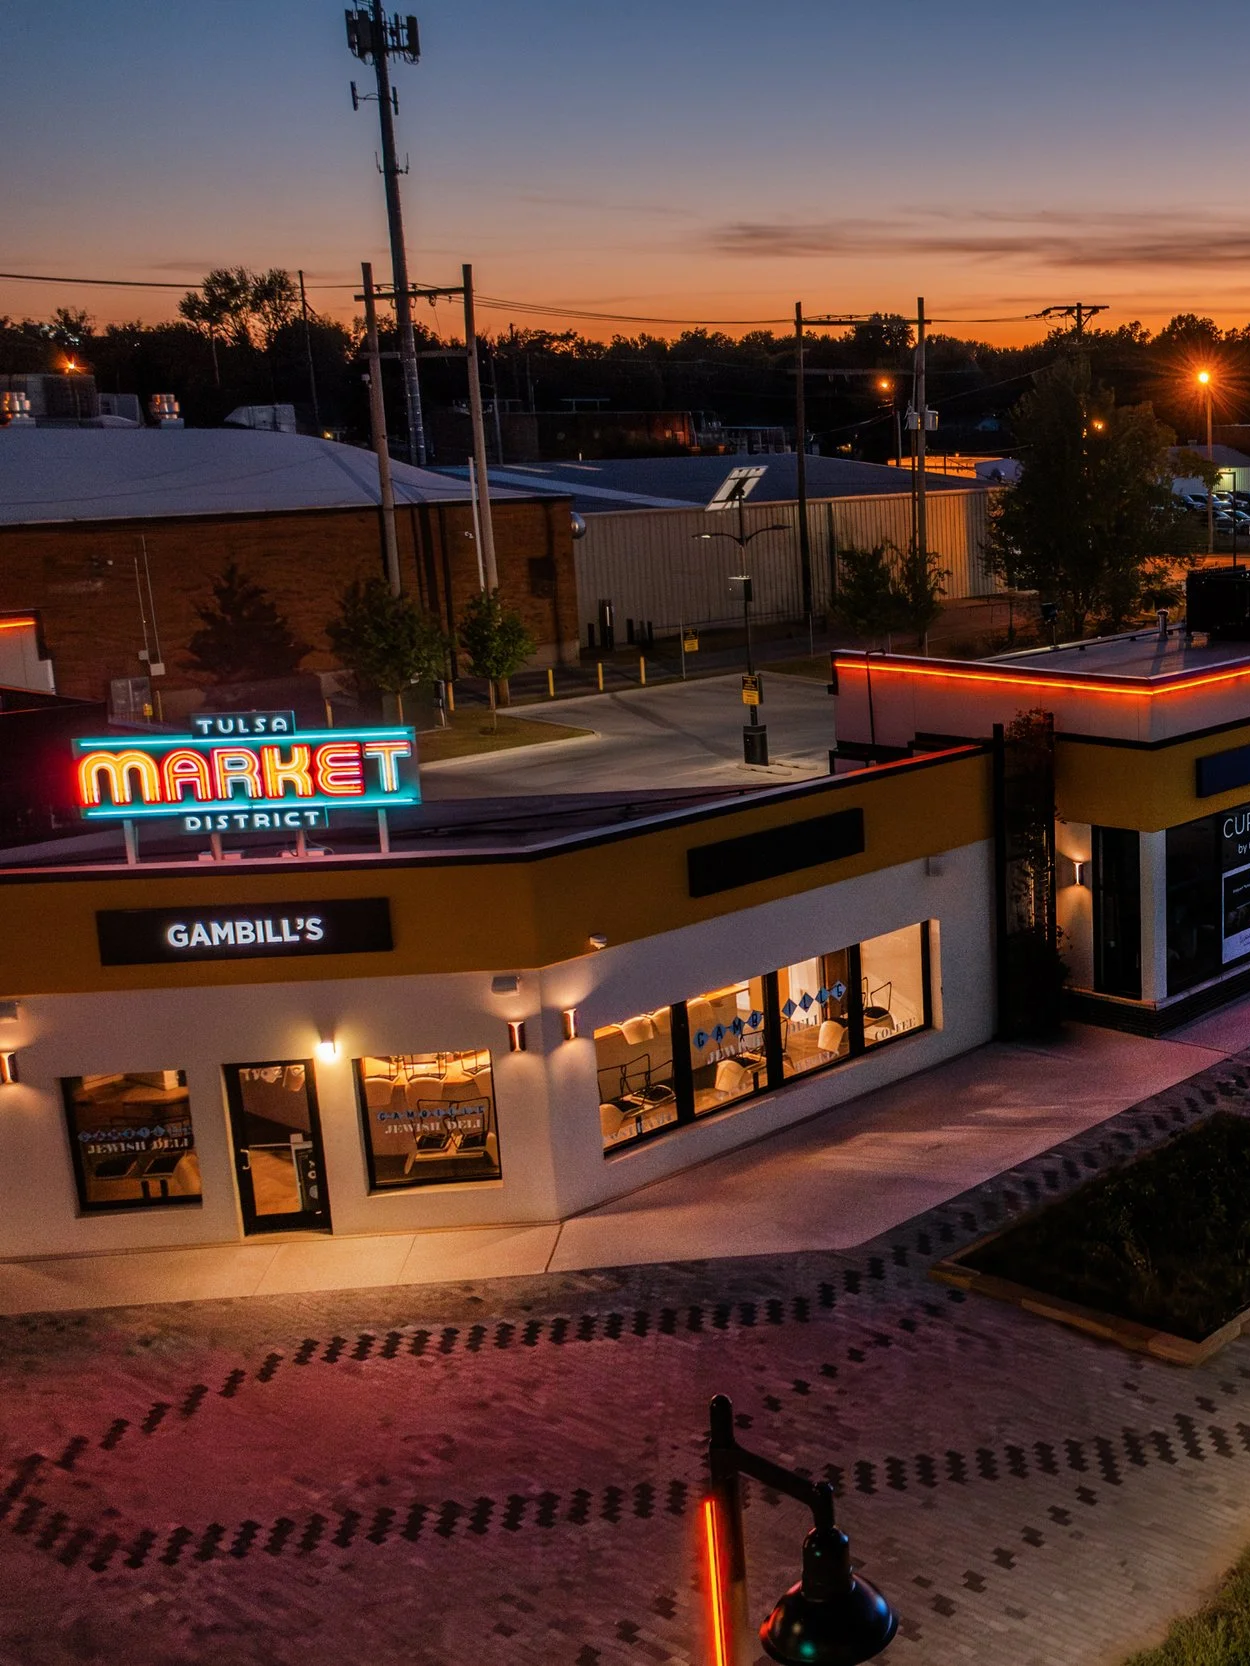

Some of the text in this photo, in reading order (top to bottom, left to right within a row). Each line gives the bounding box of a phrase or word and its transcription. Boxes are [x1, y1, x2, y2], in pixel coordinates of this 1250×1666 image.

[196, 717, 288, 735] TULSA
[78, 741, 412, 807] MARKET
[185, 811, 320, 832] DISTRICT
[1238, 843, 1248, 855] by
[167, 917, 324, 948] GAMBILL'S
[385, 1121, 441, 1135] JEWISH
[87, 1140, 147, 1155] JEWISH
